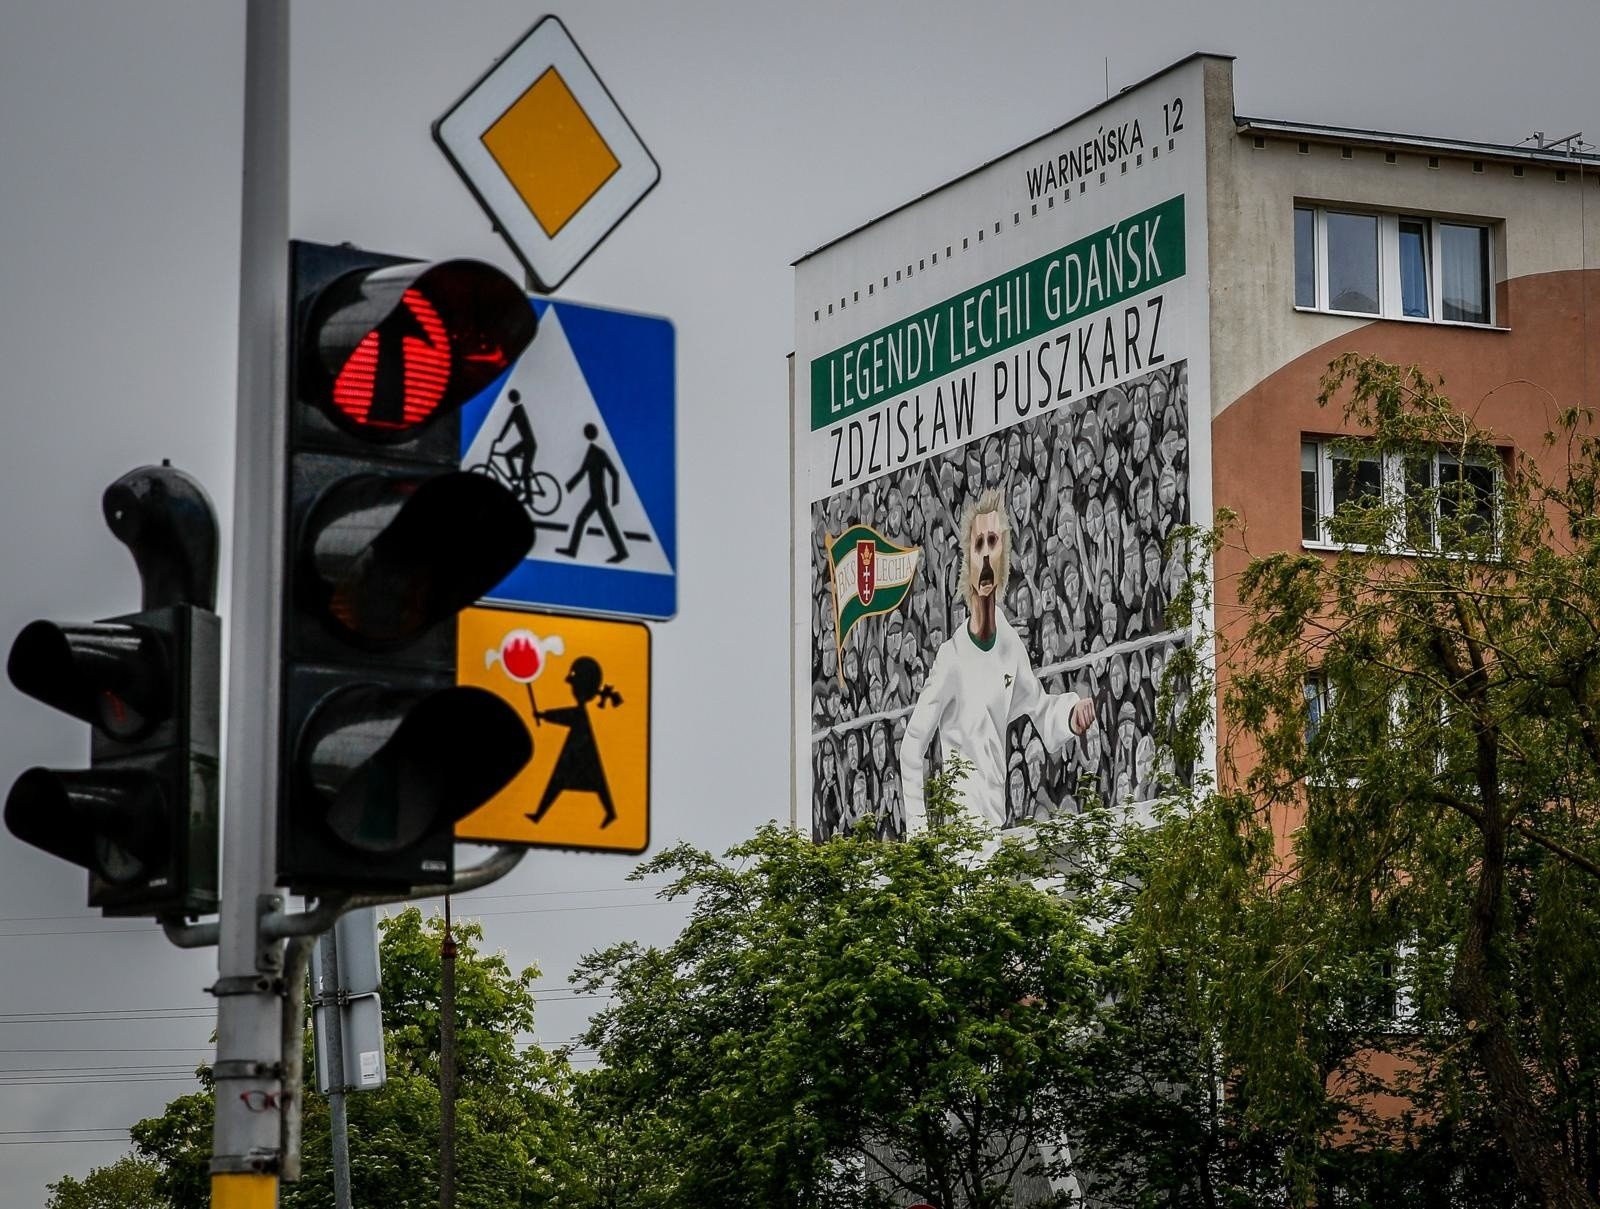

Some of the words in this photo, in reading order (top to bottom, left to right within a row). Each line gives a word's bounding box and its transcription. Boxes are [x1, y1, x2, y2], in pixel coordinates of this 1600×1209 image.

[1026, 119, 1144, 200] WARNEŃSKA
[1162, 97, 1184, 136] 12
[830, 318, 939, 414] LEGENDY
[948, 272, 1031, 364] LECHII
[1043, 214, 1163, 322] GDAŃSK
[830, 371, 977, 490] ZDZISŁAW
[994, 294, 1166, 425] PUSZKARZ
[876, 556, 912, 581] LECHIA
